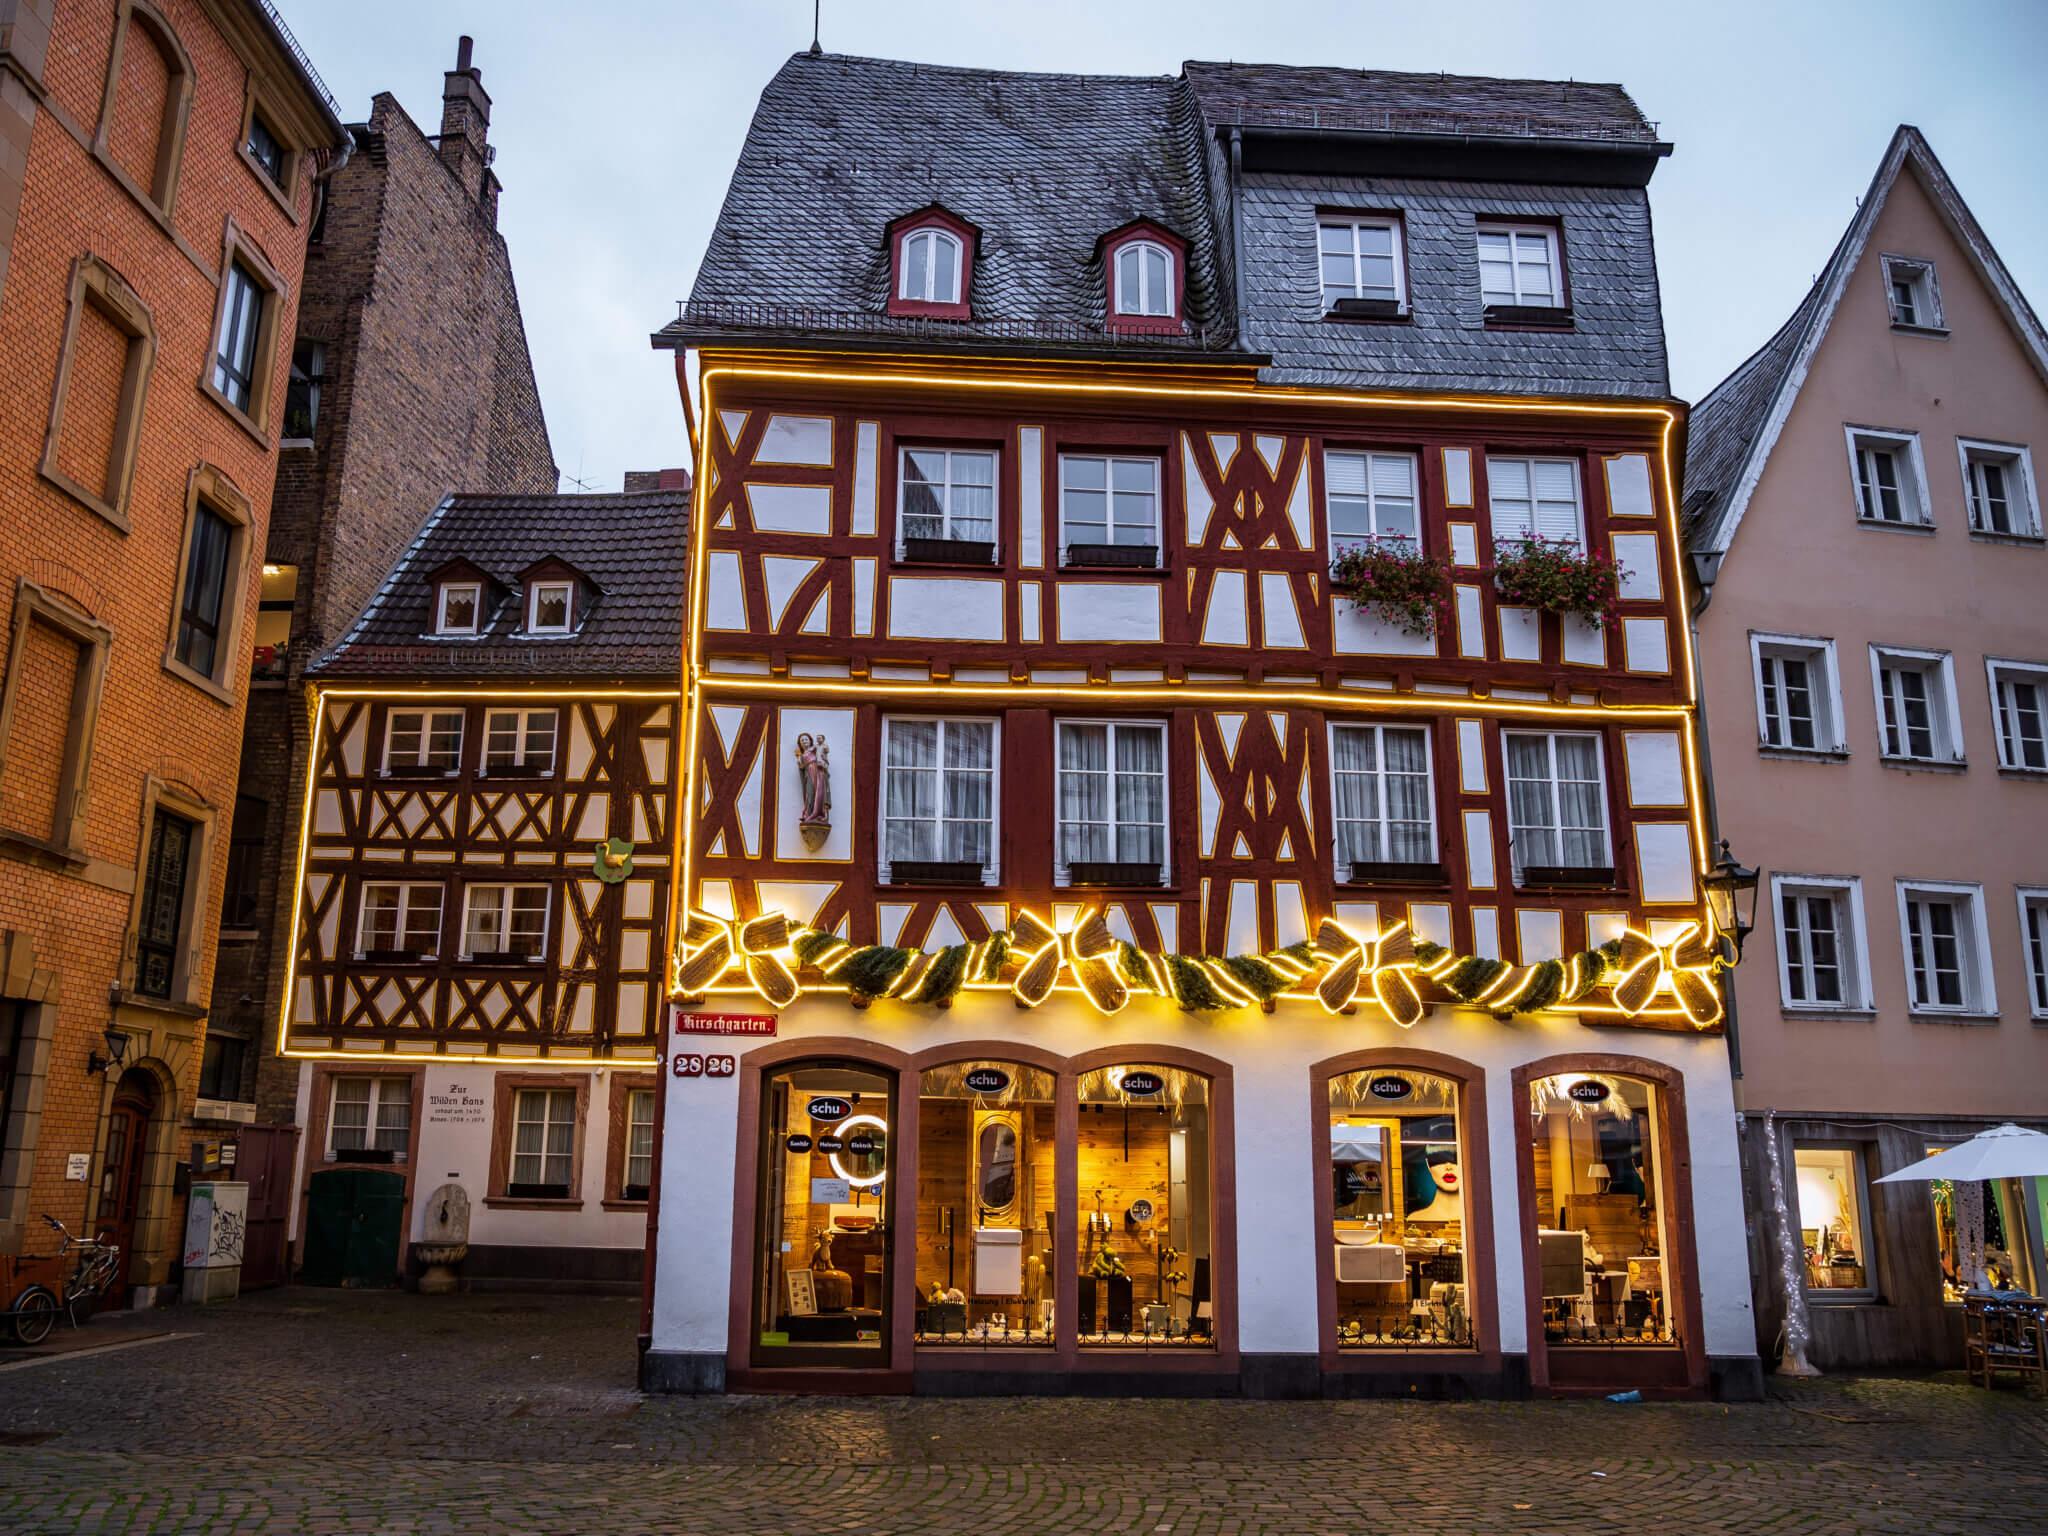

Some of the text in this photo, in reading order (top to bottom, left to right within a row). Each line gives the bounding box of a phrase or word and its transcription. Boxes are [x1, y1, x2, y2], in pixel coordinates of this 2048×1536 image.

[675, 1057, 702, 1073] 28
[707, 1057, 733, 1074] 26
[449, 1084, 467, 1094] Zur
[429, 1095, 485, 1106] Wilden Gans
